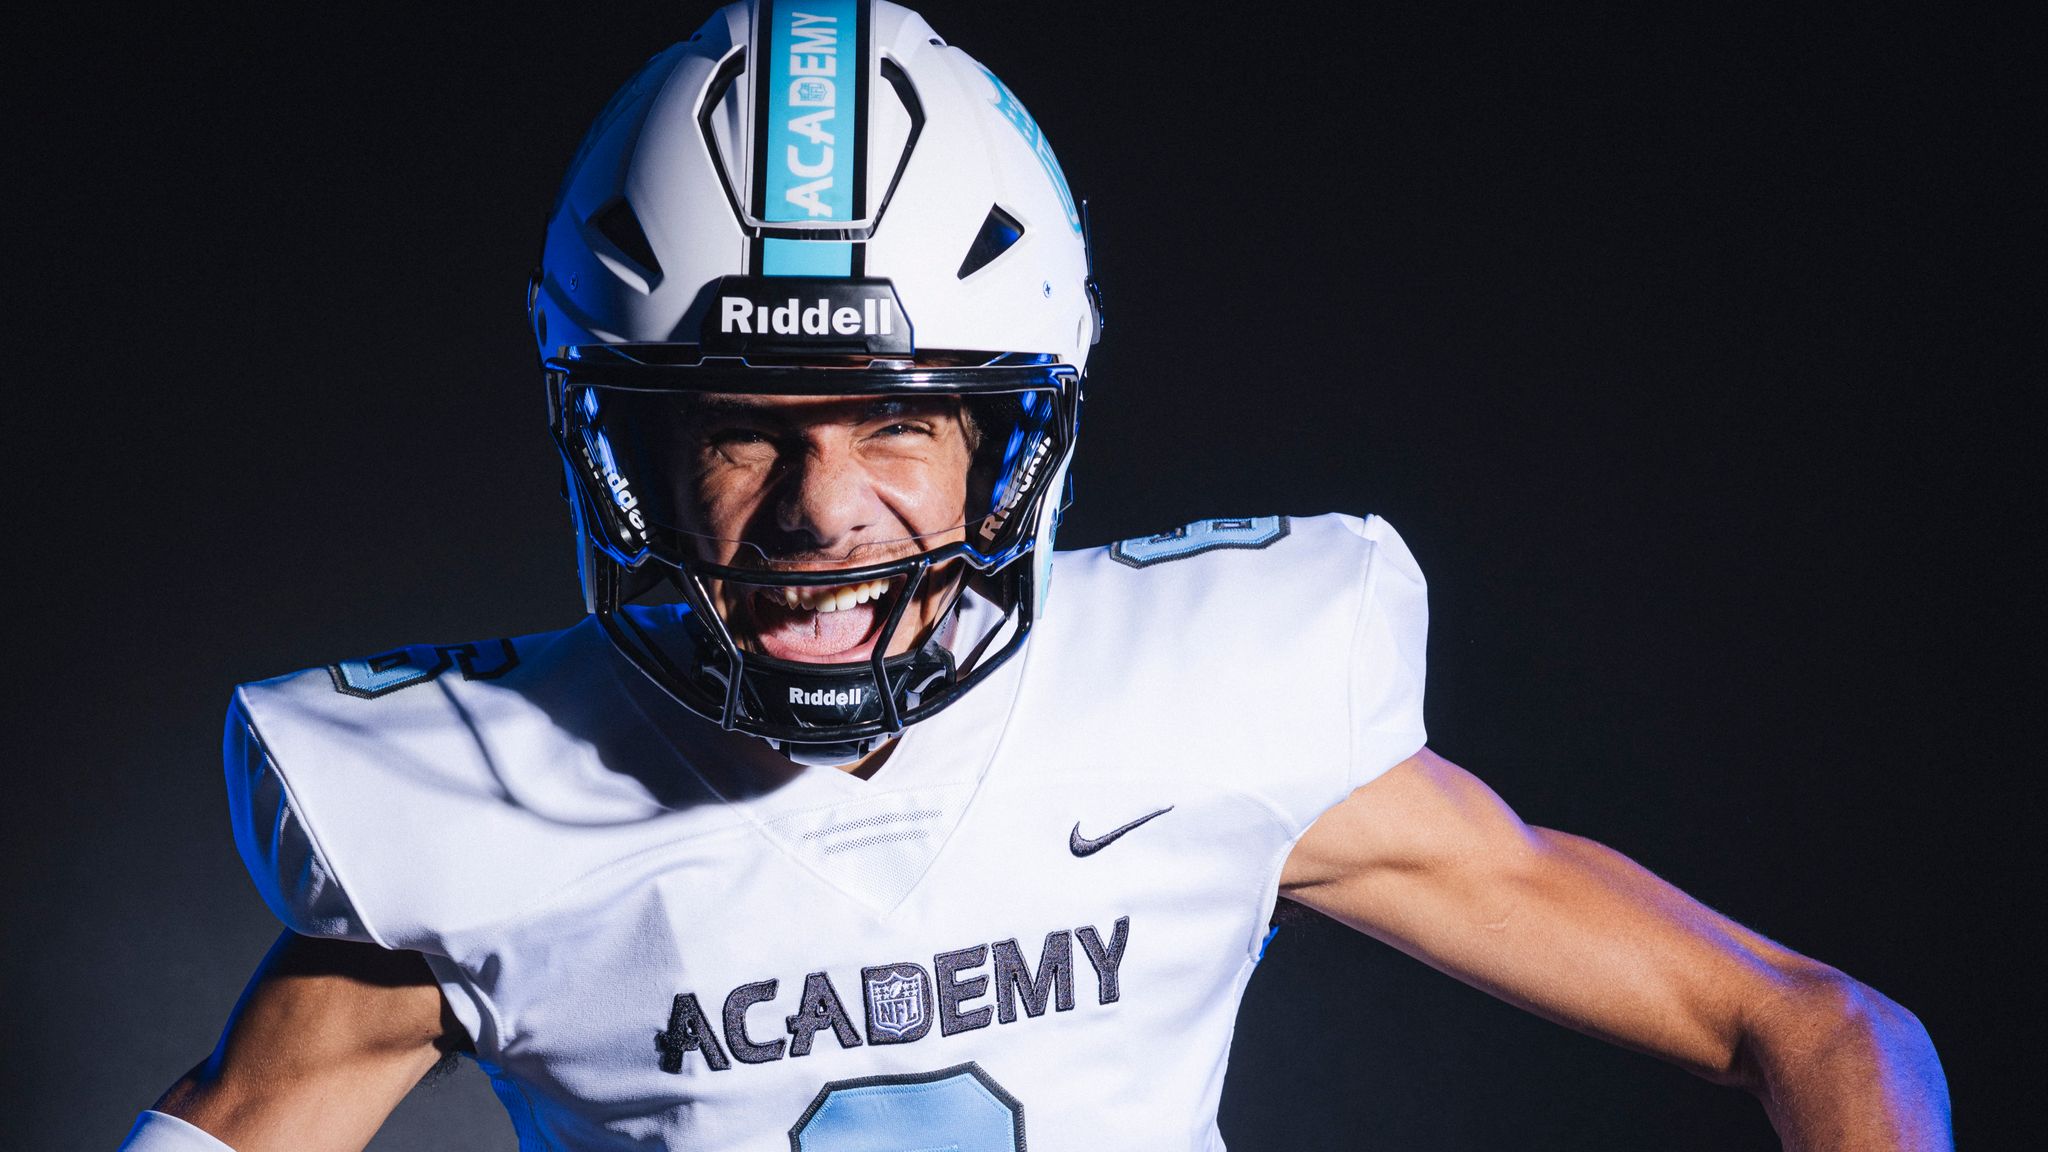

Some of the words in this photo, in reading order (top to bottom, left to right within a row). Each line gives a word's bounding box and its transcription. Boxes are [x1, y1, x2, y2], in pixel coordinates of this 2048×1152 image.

[786, 12, 838, 218] ACADEMY
[721, 296, 892, 335] Riddell
[789, 687, 862, 706] Riddell
[655, 915, 1130, 1075] ACADEMY
[876, 996, 920, 1025] NFL
